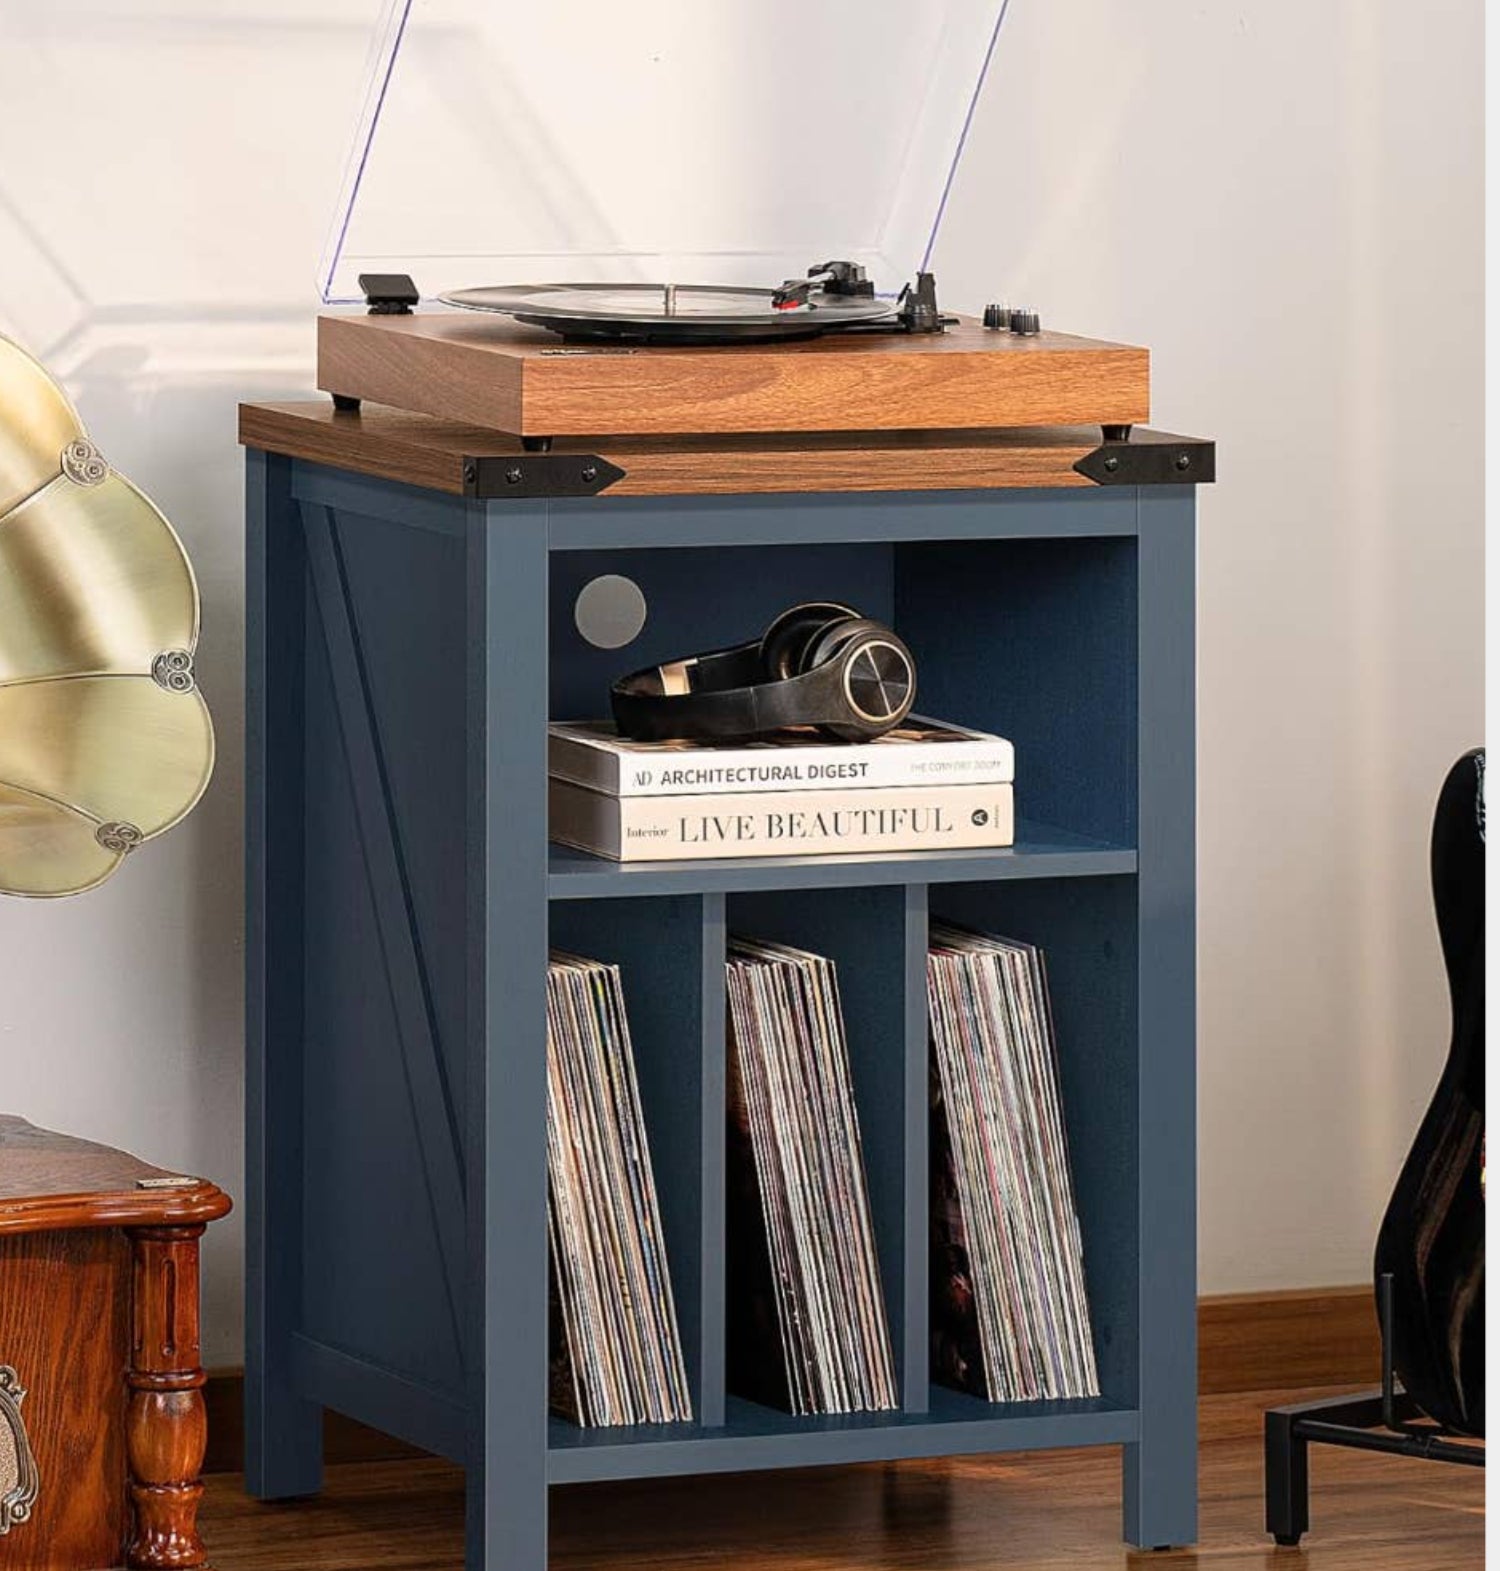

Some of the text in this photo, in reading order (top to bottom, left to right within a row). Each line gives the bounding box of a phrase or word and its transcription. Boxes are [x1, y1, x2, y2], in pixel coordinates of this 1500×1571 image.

[632, 762, 869, 787] AD ARCHITECTURAL DIGEST
[627, 825, 670, 838] Interior
[680, 814, 755, 843] LIVE
[765, 806, 953, 840] BEAUTIFUL
